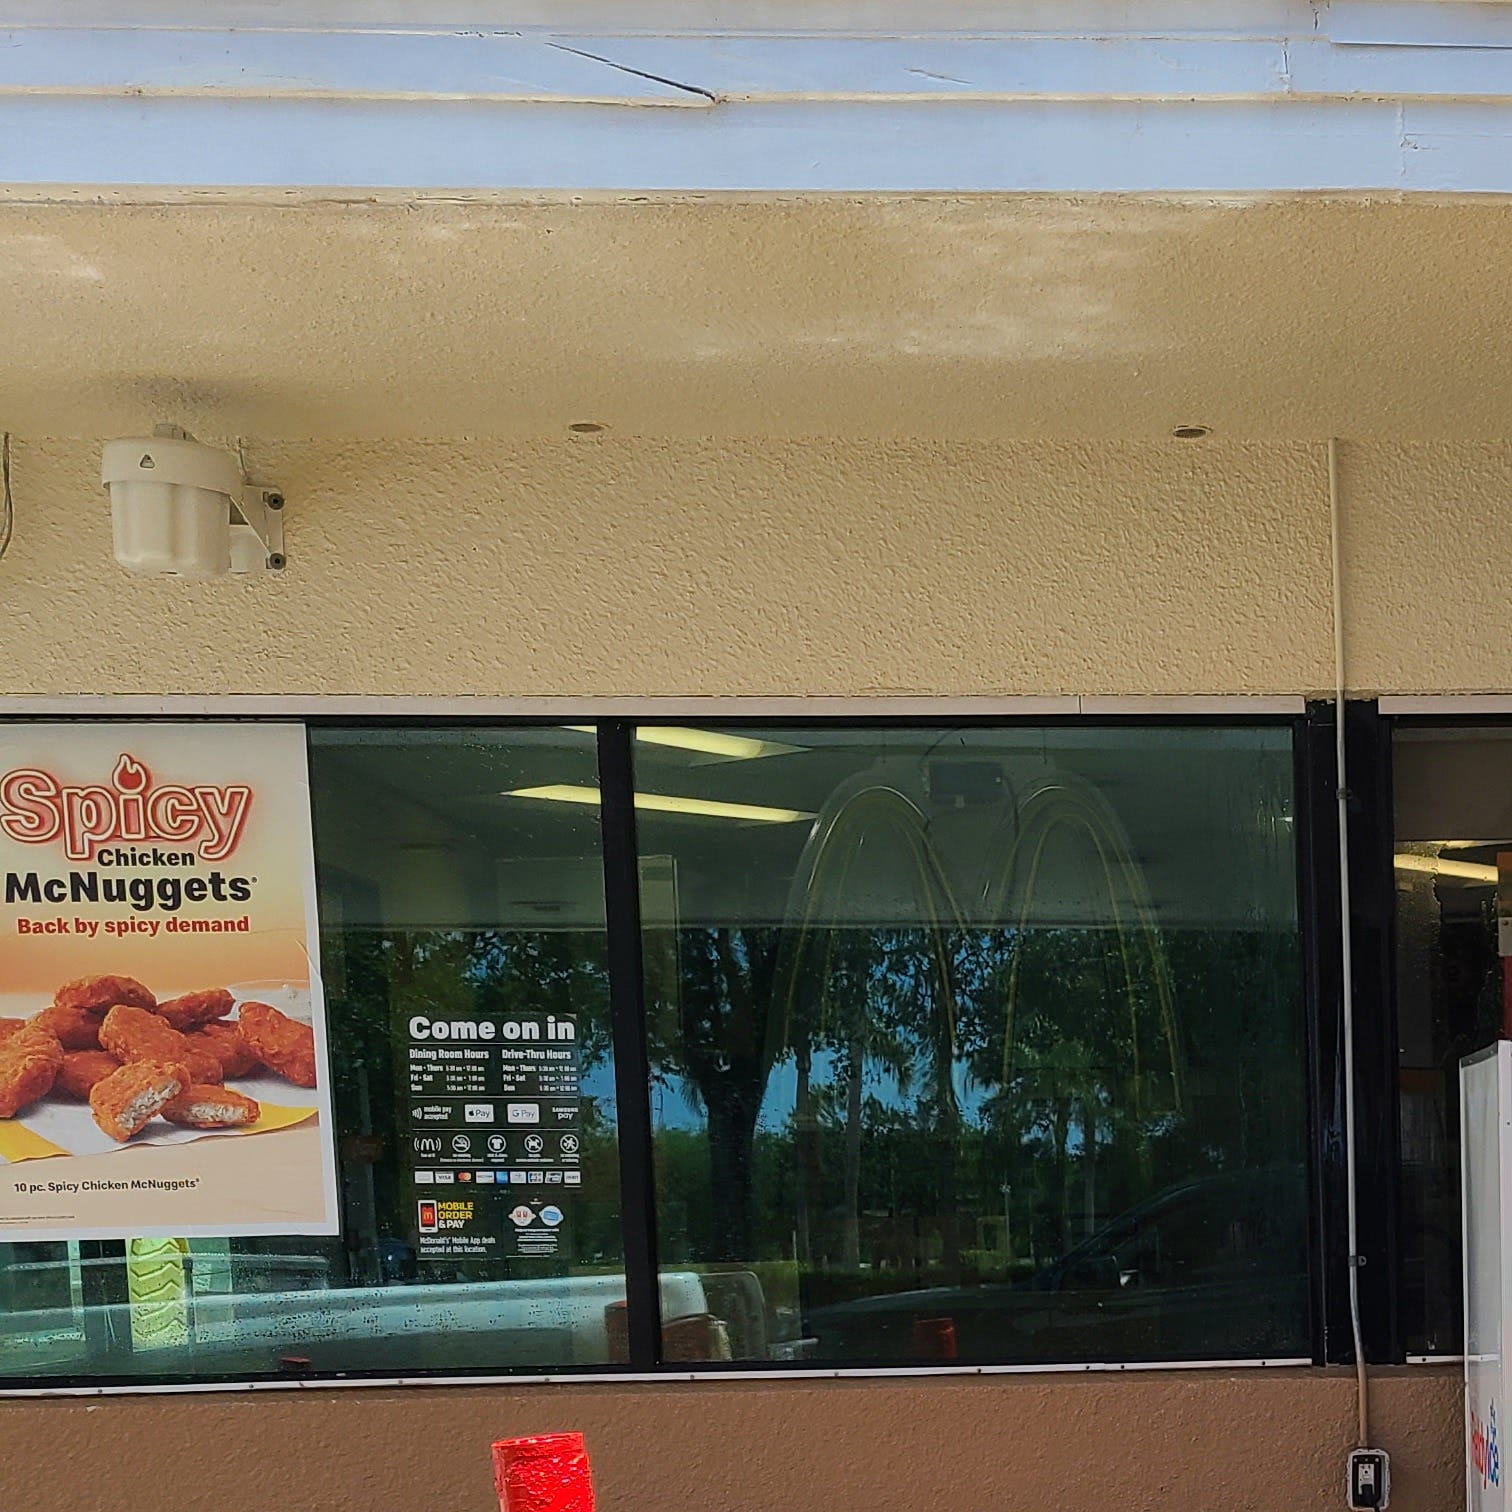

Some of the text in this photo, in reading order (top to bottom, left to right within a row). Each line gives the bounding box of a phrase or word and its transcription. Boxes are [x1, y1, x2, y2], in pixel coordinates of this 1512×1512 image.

[0, 754, 253, 861] Spicy
[97, 848, 195, 867] Chicken
[5, 871, 252, 911] McNuggets
[17, 915, 250, 938] Back by spicy demand
[409, 1015, 575, 1040] Come on in
[409, 1048, 490, 1060] Dining Room Hours
[502, 1049, 571, 1060] Drive-Thru Hours
[475, 1109, 490, 1118] Pay
[521, 1109, 535, 1119] Pay
[14, 1179, 197, 1194] 10 pc. Spicy Chicken McNuggets
[438, 1201, 475, 1211] MOBILE
[438, 1211, 473, 1220] ORDER
[446, 1220, 465, 1229] PAY
